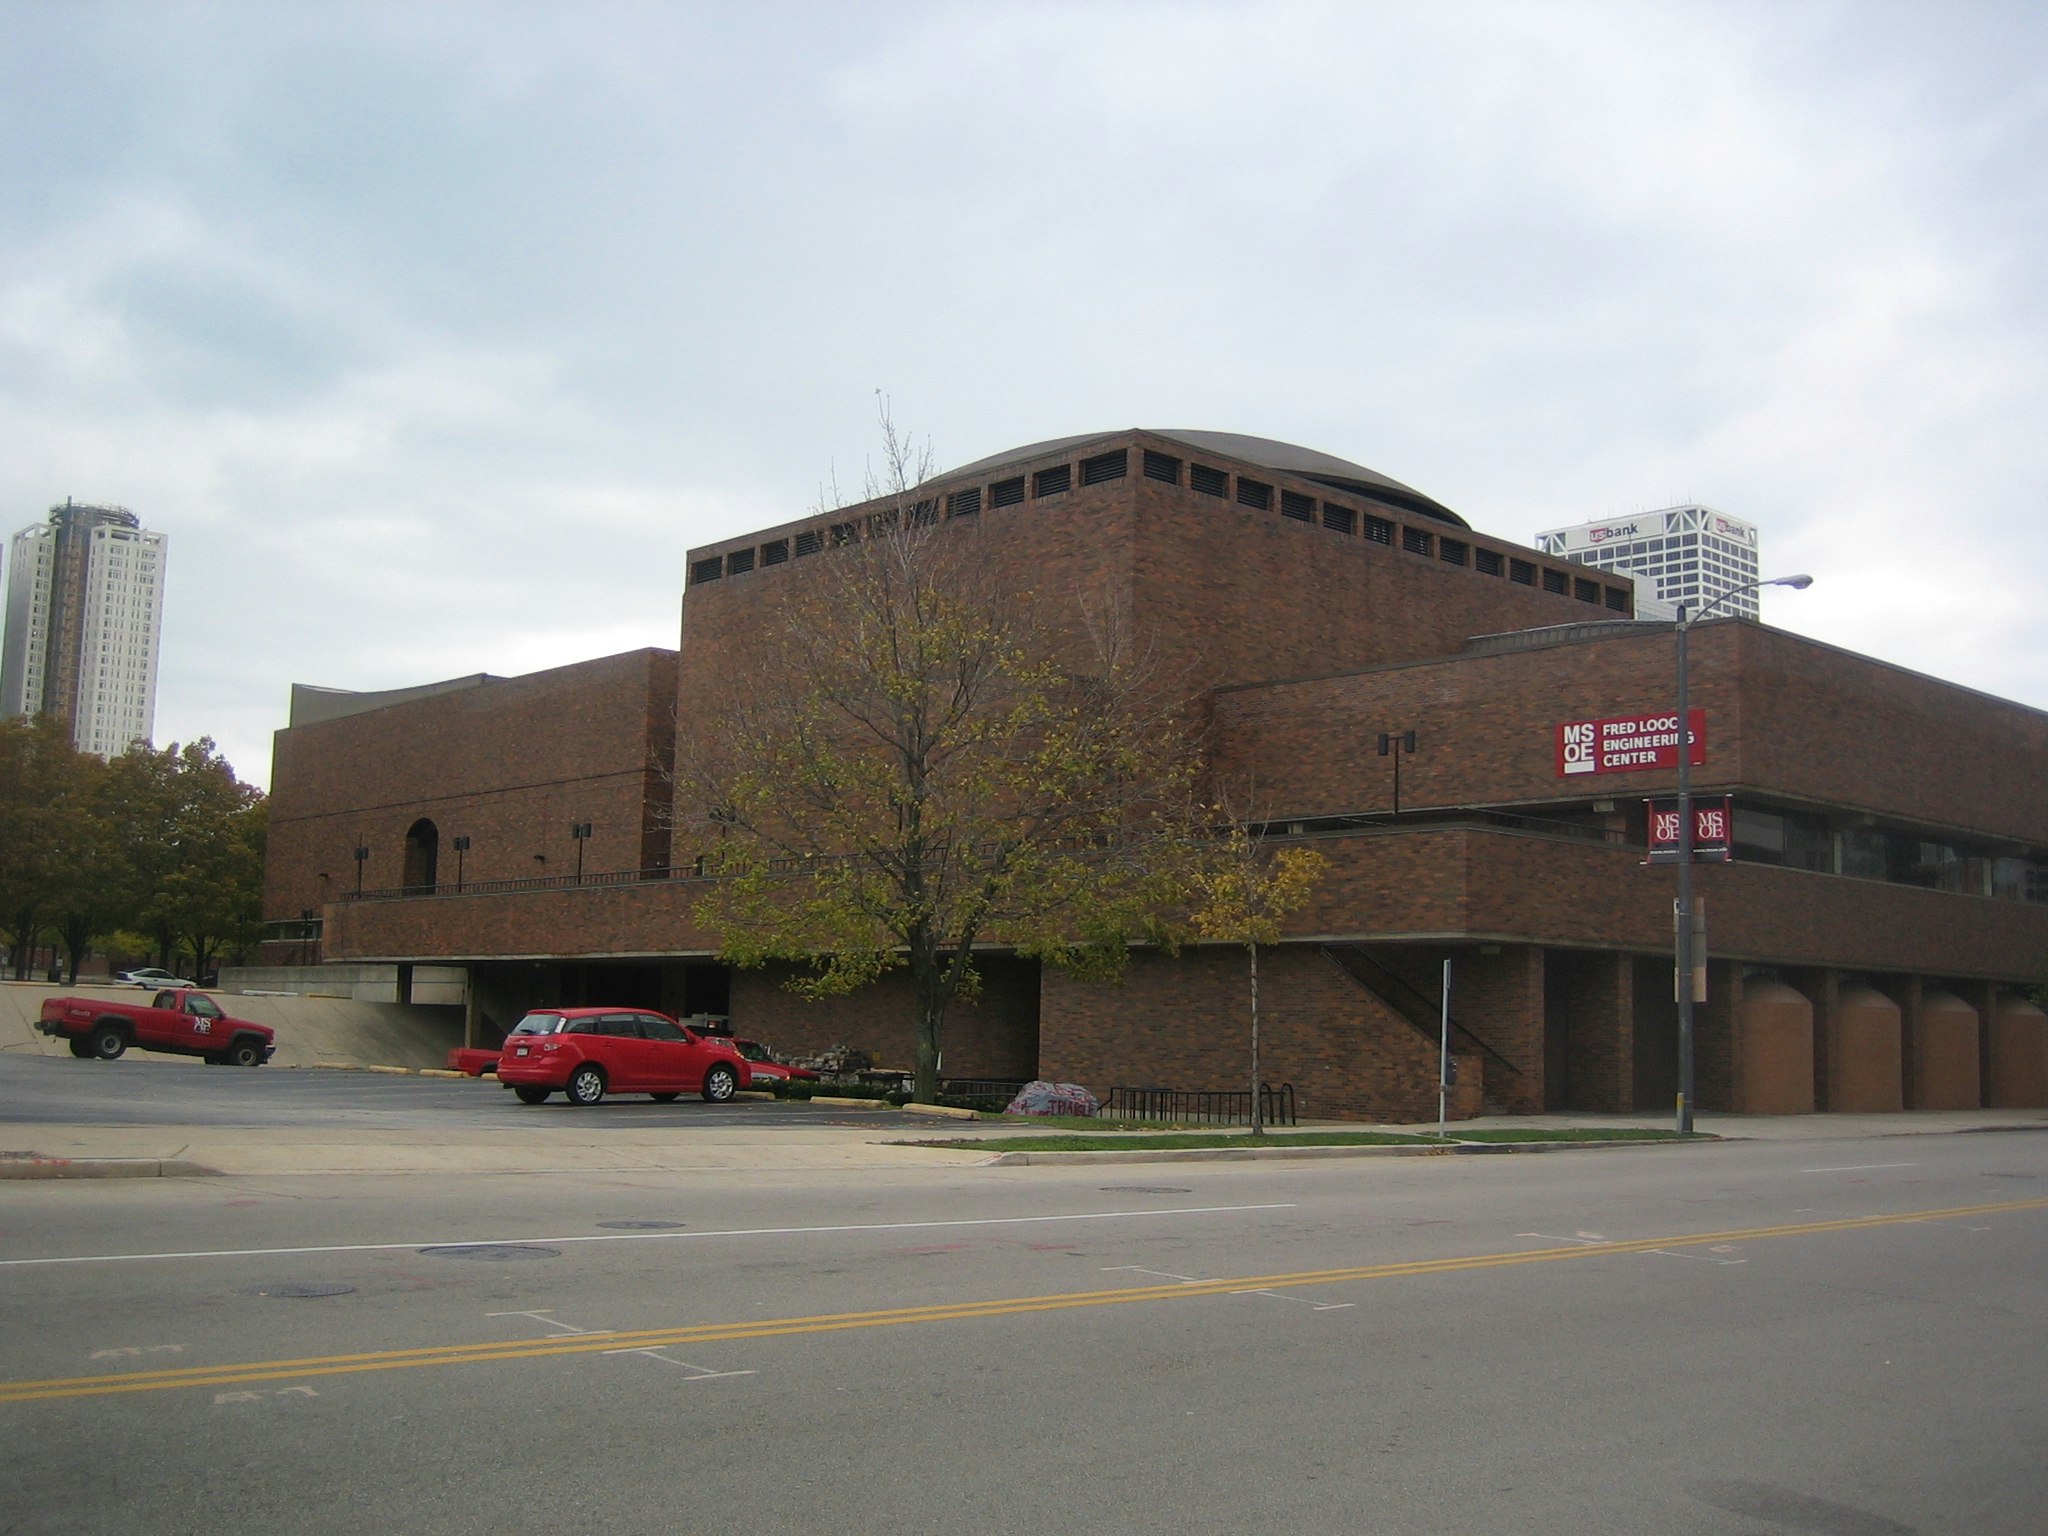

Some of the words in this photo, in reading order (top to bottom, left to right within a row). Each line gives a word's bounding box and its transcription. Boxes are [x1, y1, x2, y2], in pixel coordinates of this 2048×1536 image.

[1564, 723, 1595, 744] MS
[1602, 722, 1636, 736] FRED
[1639, 717, 1679, 733] LOOC
[1603, 731, 1695, 752] ENGINEERIG
[1564, 742, 1595, 763] OE
[1603, 751, 1657, 767] CENTER
[1656, 813, 1680, 828] MS
[1698, 811, 1723, 826] MS
[1698, 824, 1724, 839] OE
